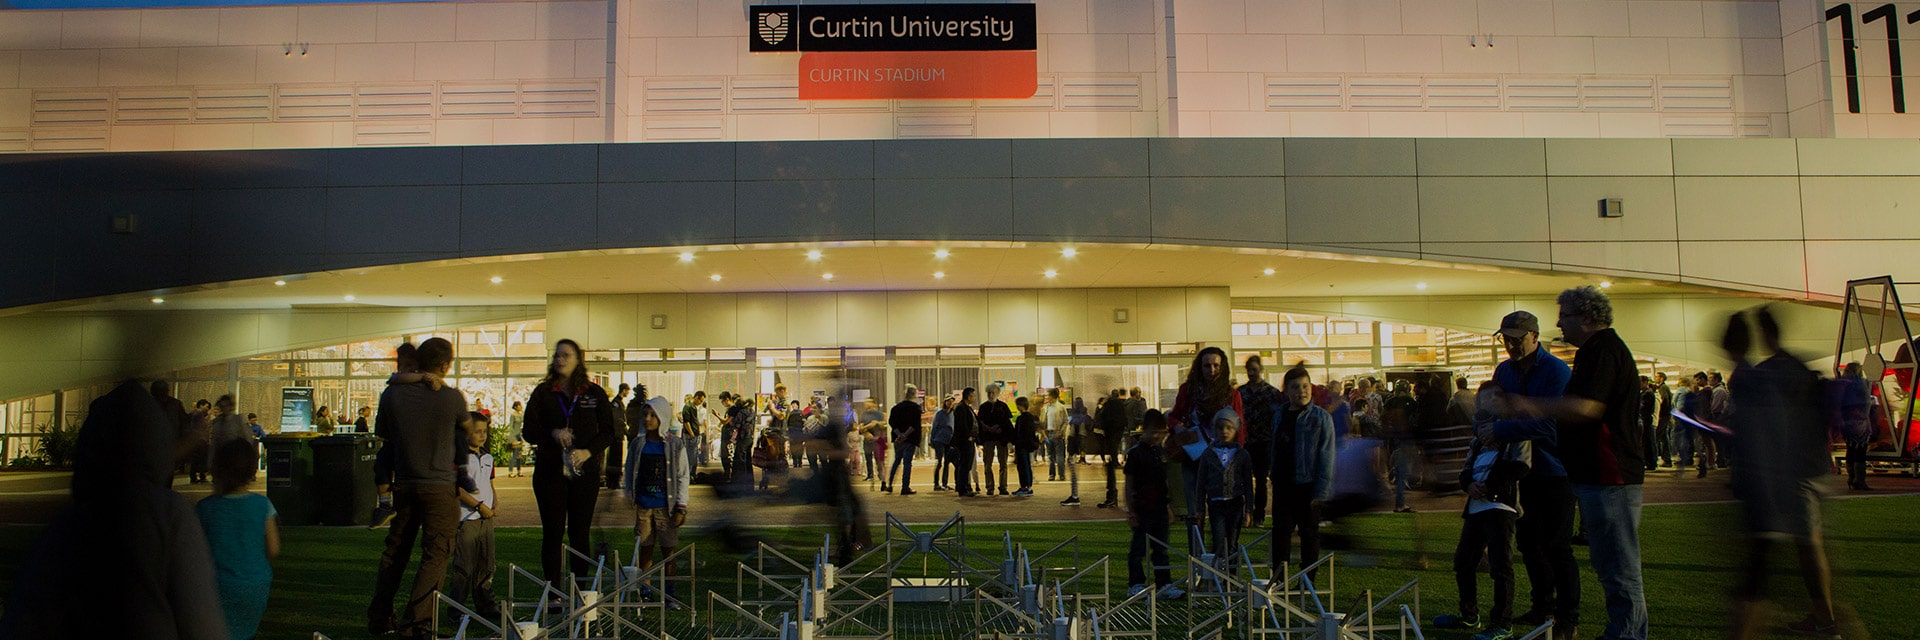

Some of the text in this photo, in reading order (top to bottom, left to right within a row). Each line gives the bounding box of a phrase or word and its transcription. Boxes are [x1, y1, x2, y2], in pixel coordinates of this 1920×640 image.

[809, 15, 1014, 42] Curtin University
[1825, 3, 1920, 113] 11
[809, 67, 945, 83] CURTIN STADIUM
